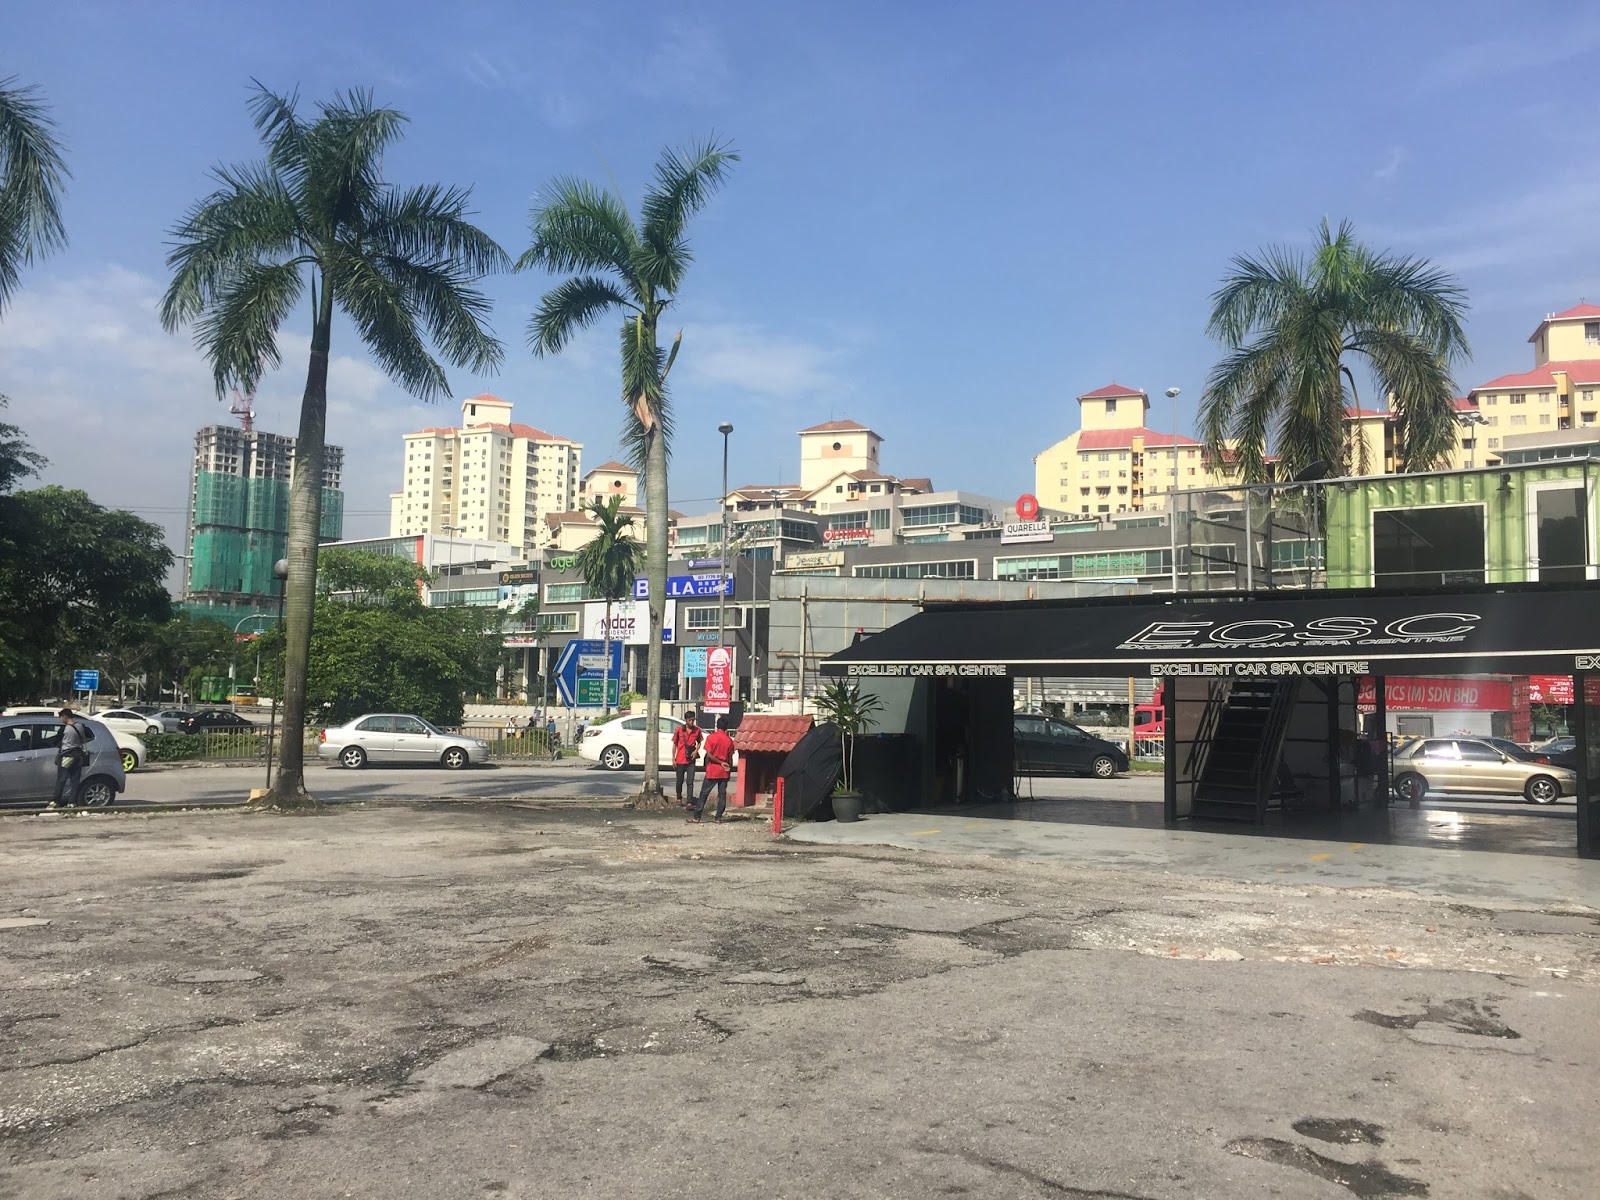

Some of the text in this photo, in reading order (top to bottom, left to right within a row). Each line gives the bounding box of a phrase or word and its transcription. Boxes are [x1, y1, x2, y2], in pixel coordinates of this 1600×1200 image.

[1007, 523, 1047, 534] QUARELLA
[636, 579, 695, 597] BLA
[698, 585, 729, 594] CLINC
[1124, 612, 1482, 644] ECSC
[1115, 635, 1466, 650] EXCELLENT CAR SPA CENTRE
[847, 664, 1006, 676] EXCELLENT CAR SPA CENTRE
[1150, 661, 1369, 675] EXCELLENT CAR SPA CENTRE
[1358, 685, 1478, 704] OGITICS (M) SDN BHD
